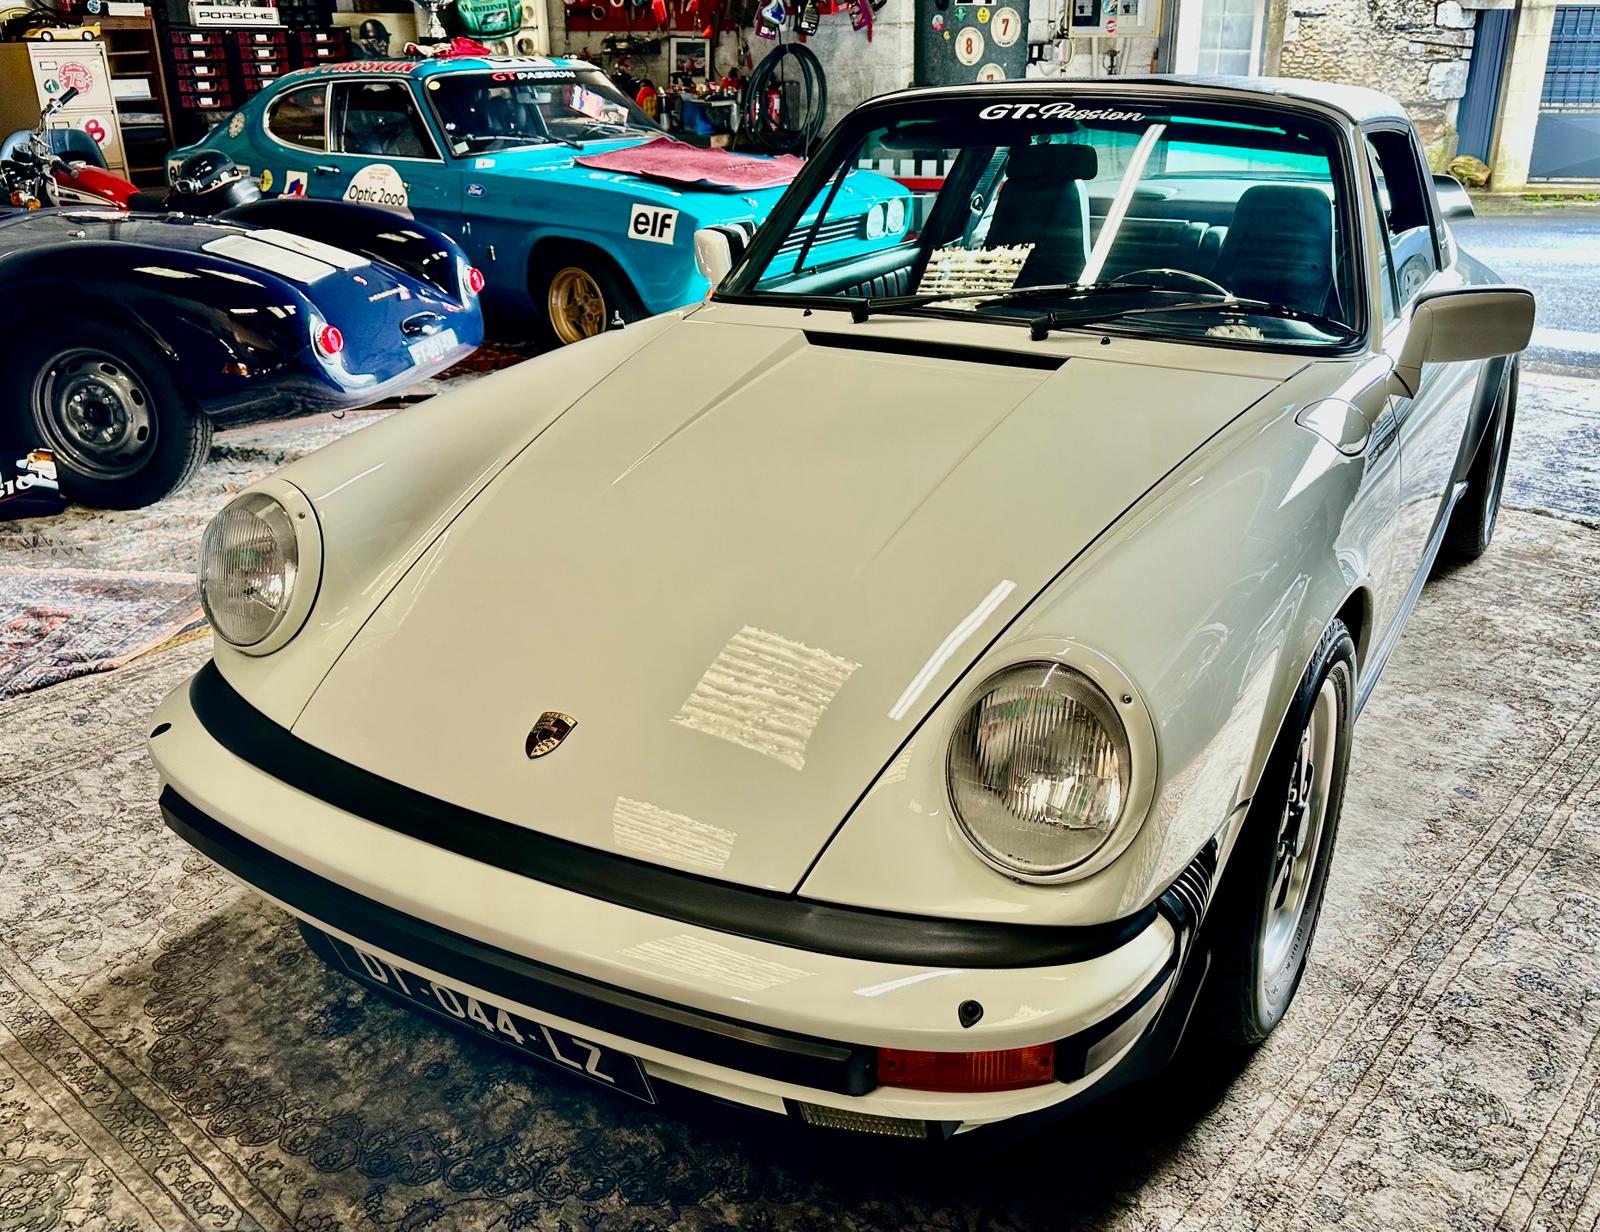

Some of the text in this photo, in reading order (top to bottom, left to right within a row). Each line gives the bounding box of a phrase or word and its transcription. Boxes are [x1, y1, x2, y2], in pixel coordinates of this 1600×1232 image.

[199, 11, 275, 20] PORSCHE
[1002, 18, 1010, 36] 7
[965, 37, 973, 55] 8
[84, 119, 105, 143] 8
[349, 184, 405, 206] Optic 2000
[633, 211, 673, 238] elf
